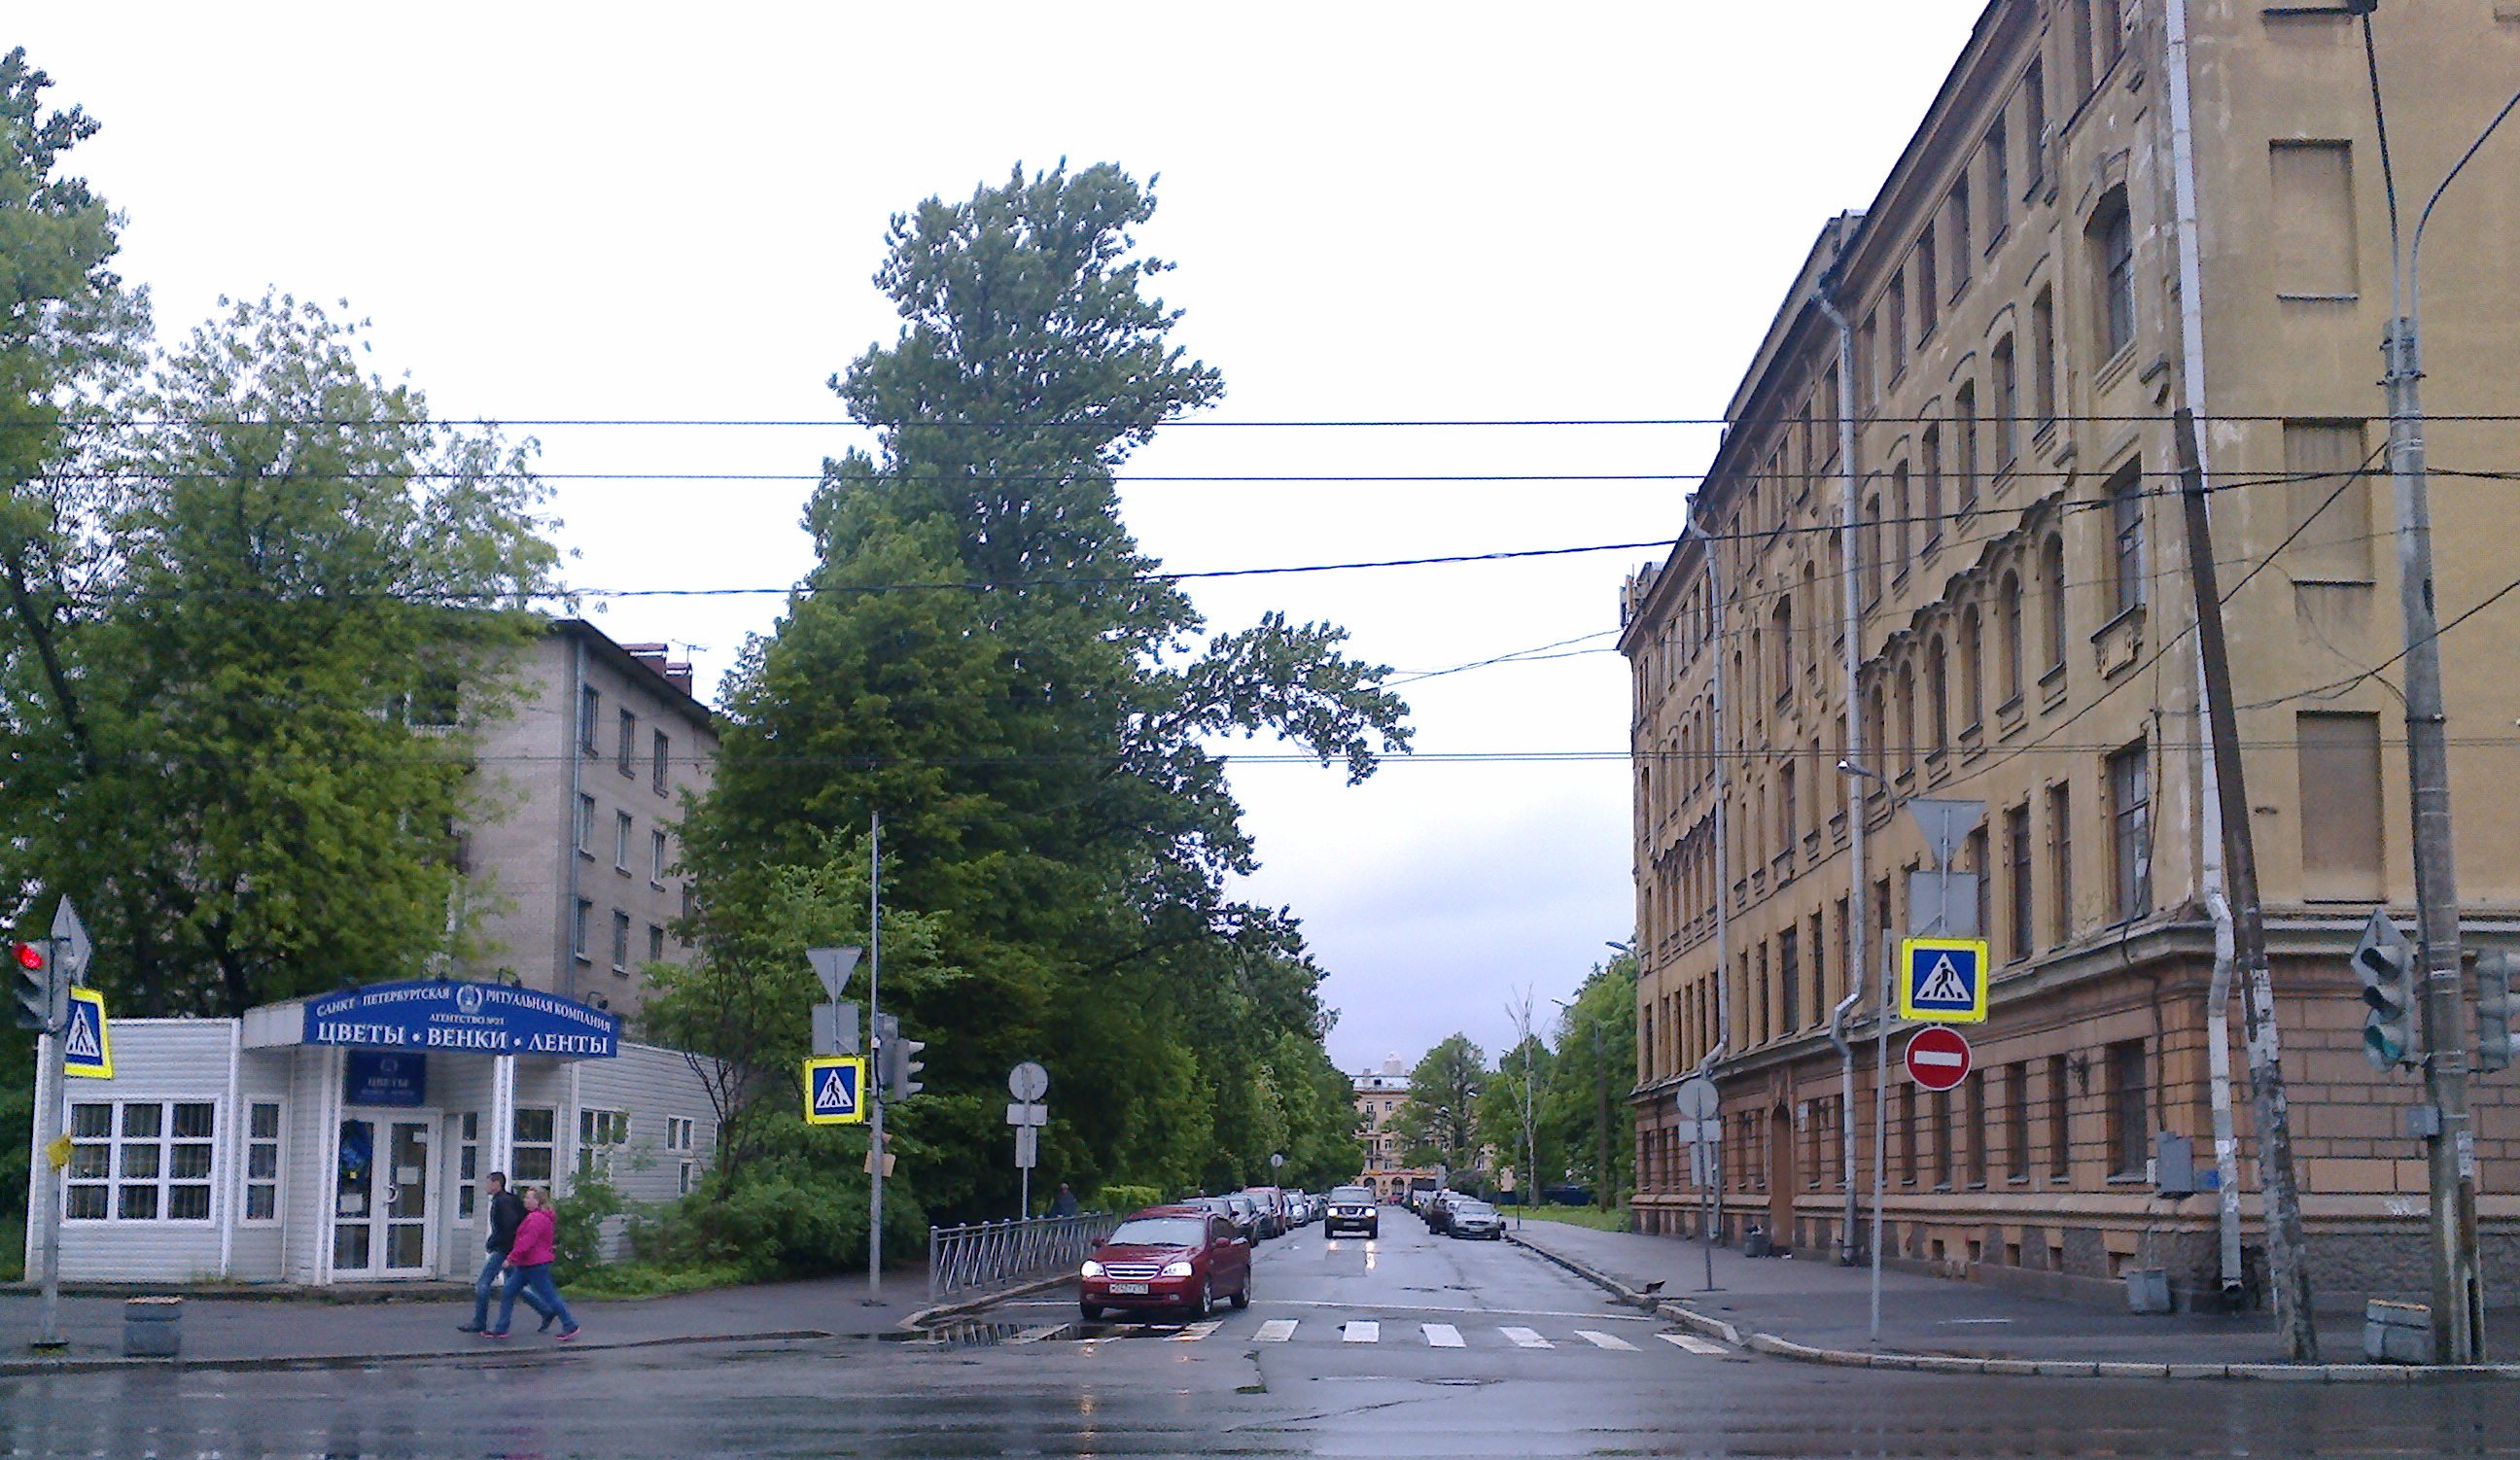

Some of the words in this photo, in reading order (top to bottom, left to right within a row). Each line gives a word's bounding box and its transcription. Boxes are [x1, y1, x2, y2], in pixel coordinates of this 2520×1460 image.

[316, 996, 356, 1018] САНКТ
[363, 987, 450, 1006] ПЕТЕРБУРГСКАЯ
[486, 989, 553, 1014] РИТУАЛЬНАЯ
[554, 1002, 611, 1032] КОМПАНИЯ
[429, 1013, 485, 1025] АГЕНТСТВО
[316, 1021, 405, 1046] ЦВЕТЫ
[427, 1027, 507, 1050] ВЕНКИ
[528, 1032, 610, 1055] ЛЕНТЫ
